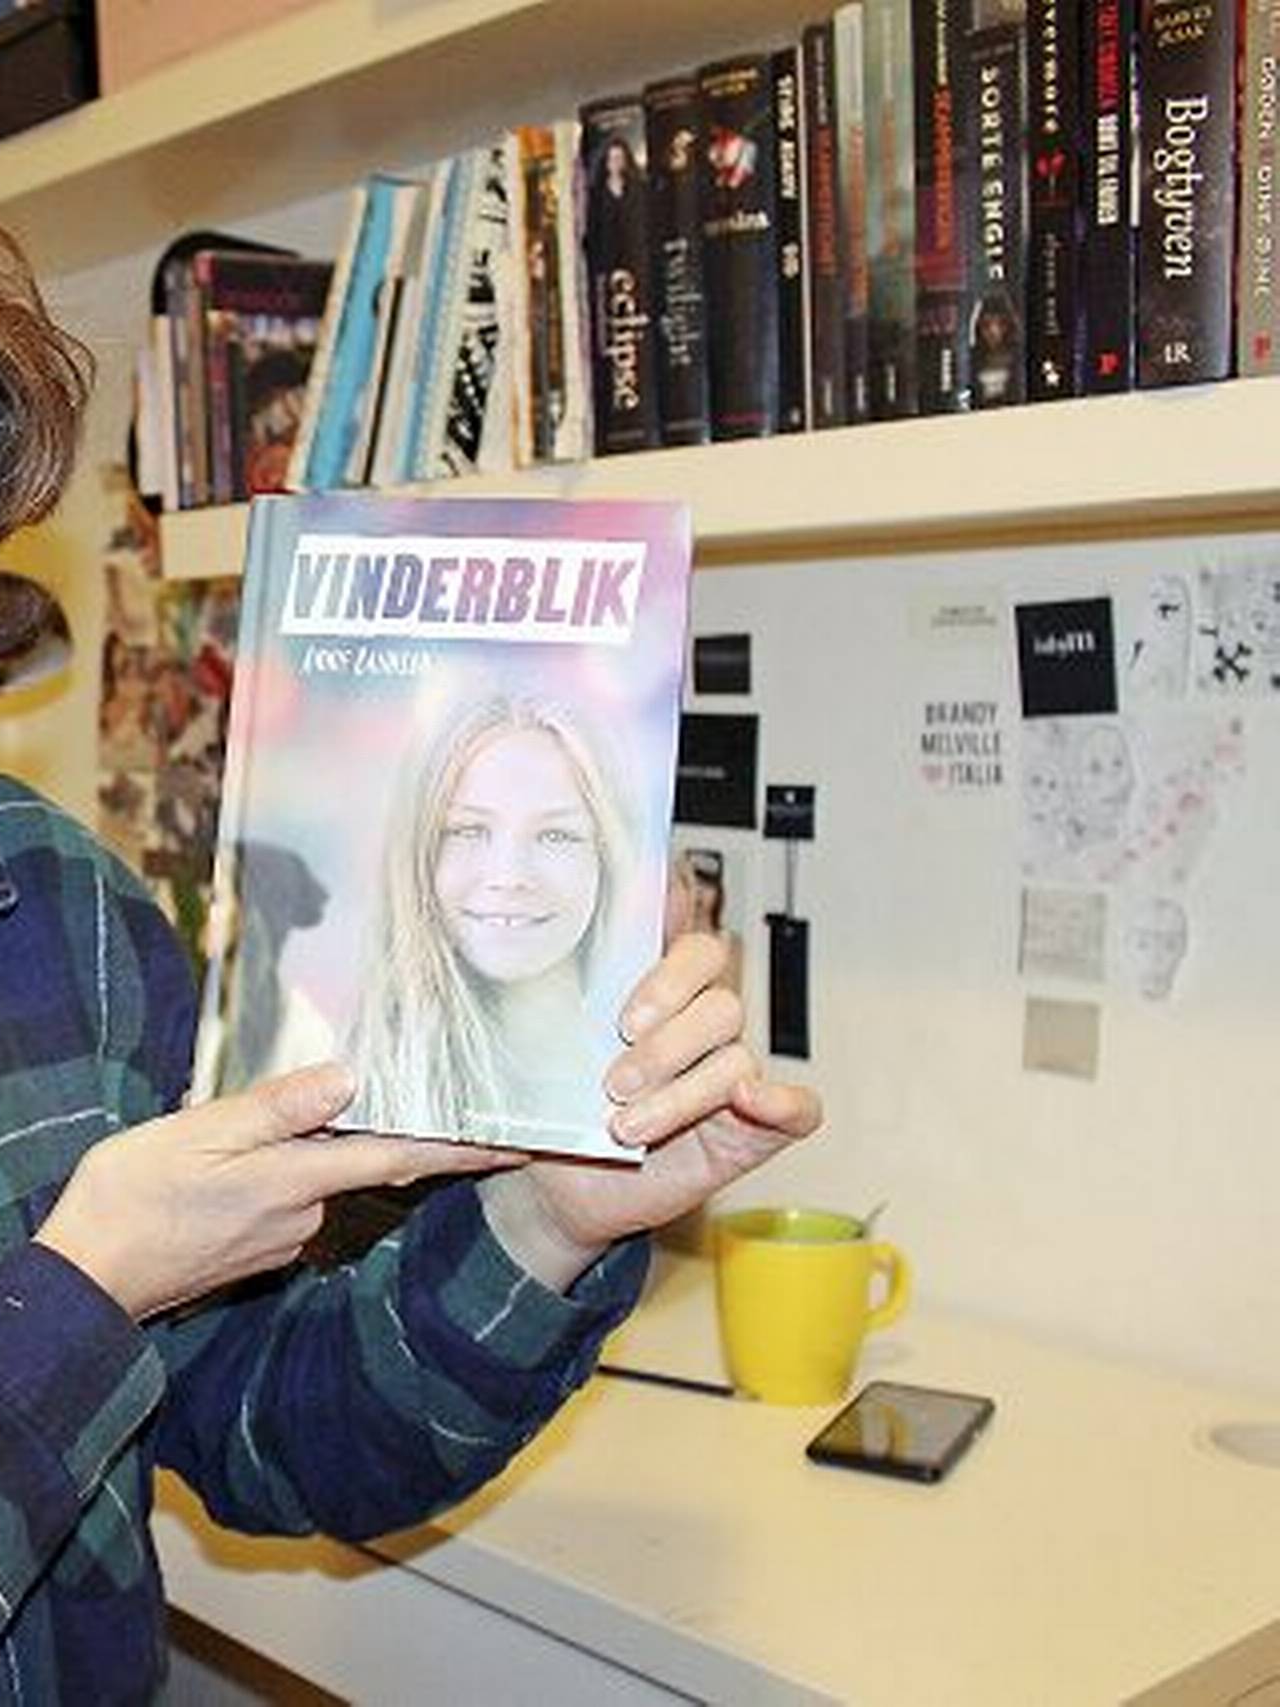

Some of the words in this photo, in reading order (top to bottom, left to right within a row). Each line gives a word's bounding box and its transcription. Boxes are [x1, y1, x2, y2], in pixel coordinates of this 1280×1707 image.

[980, 66, 1003, 170] SORTE
[1154, 94, 1208, 280] Bogtyven
[607, 268, 651, 409] eclipse
[293, 553, 636, 627] VINDERBLIK
[921, 732, 1000, 756] MELVILLE
[925, 702, 998, 725] BRANDY
[949, 764, 1003, 786] ITALIA
